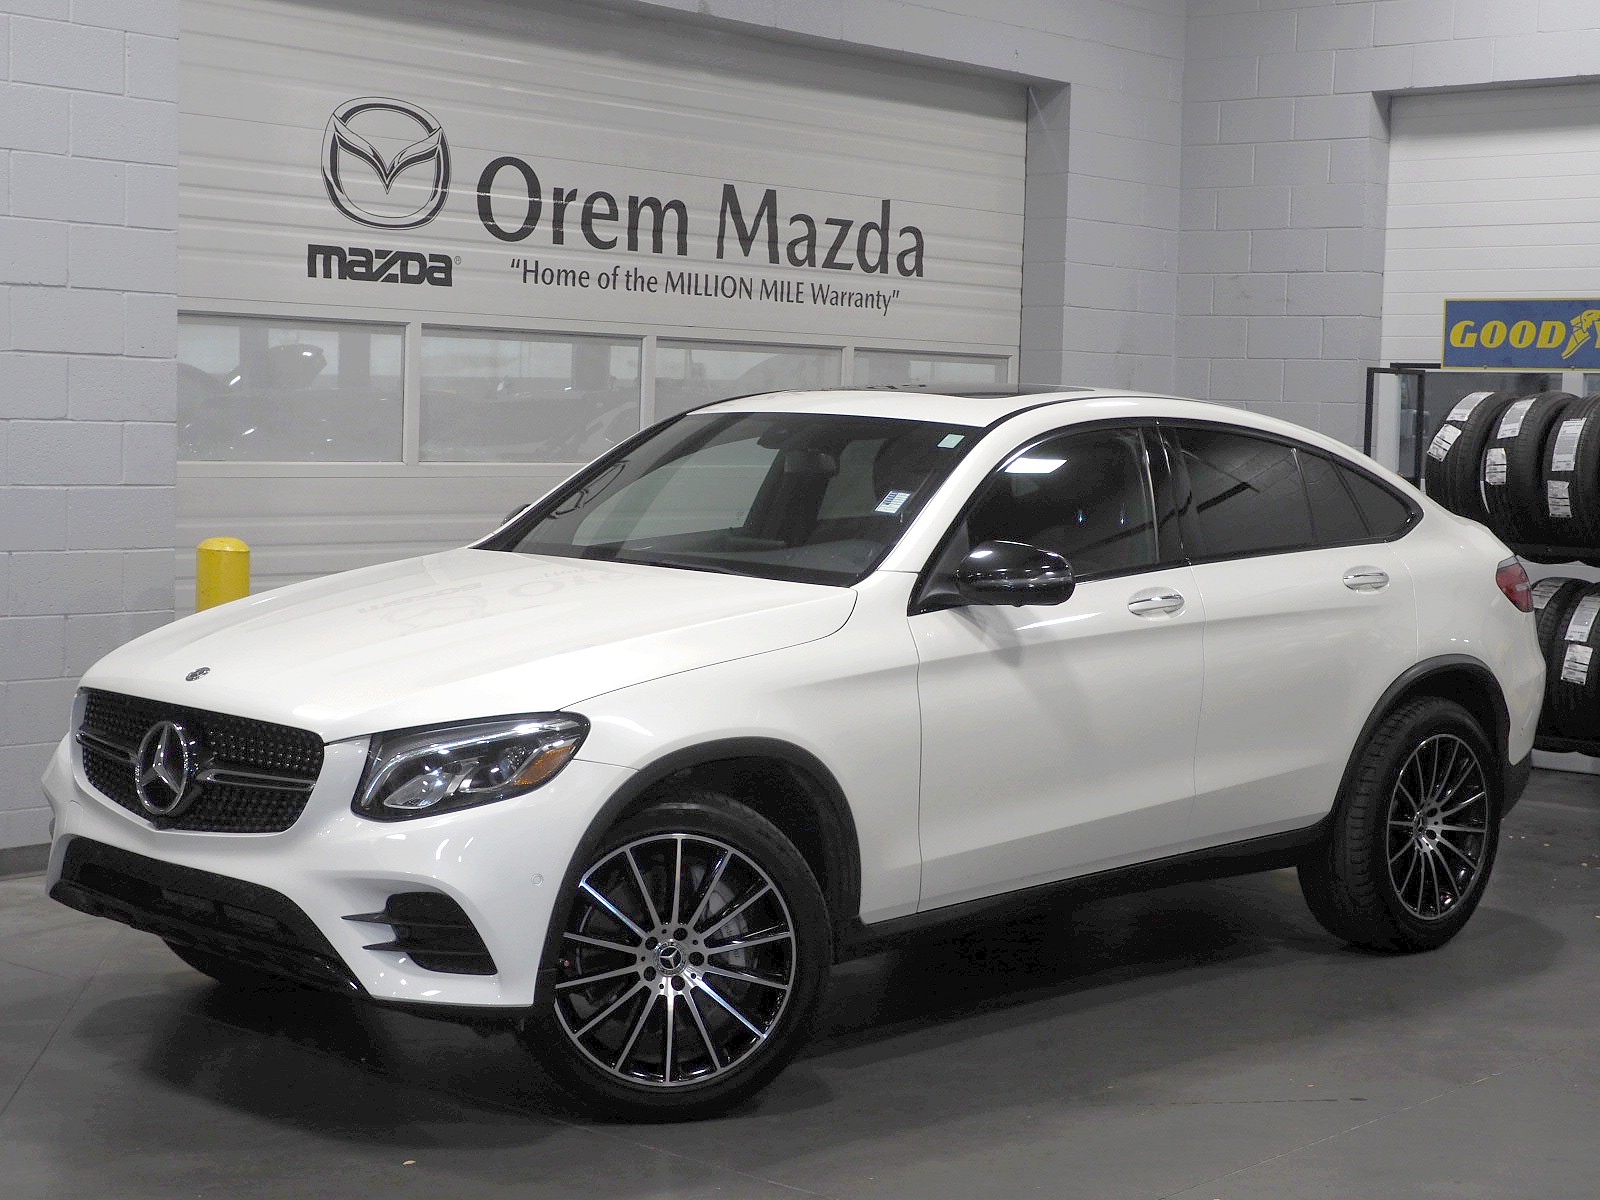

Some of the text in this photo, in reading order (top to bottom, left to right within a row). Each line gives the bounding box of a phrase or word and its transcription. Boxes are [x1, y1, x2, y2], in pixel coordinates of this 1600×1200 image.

[476, 156, 925, 278] Orem Mazda
[597, 266, 621, 290] of
[624, 267, 658, 293] the
[664, 270, 753, 300] MILLION
[759, 278, 805, 304] MILE
[1450, 319, 1600, 349] GOOD
